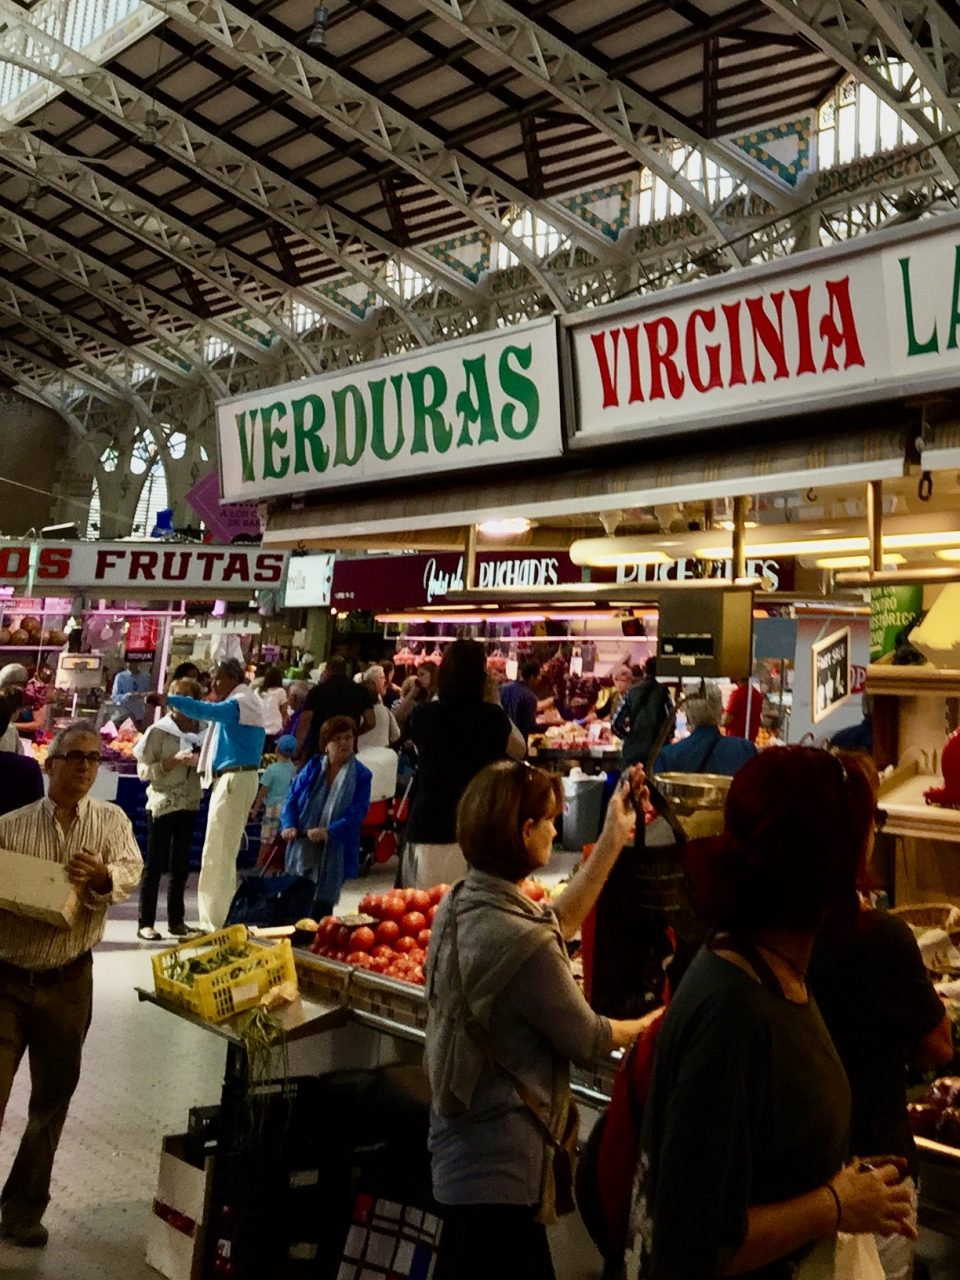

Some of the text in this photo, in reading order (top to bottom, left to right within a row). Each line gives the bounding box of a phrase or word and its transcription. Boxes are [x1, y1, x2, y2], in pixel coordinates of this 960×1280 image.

[590, 276, 866, 409] VIRGINIA
[235, 346, 541, 483] VERDURAS
[95, 549, 284, 583] FRUTAS
[478, 557, 559, 588] PUCHADES
